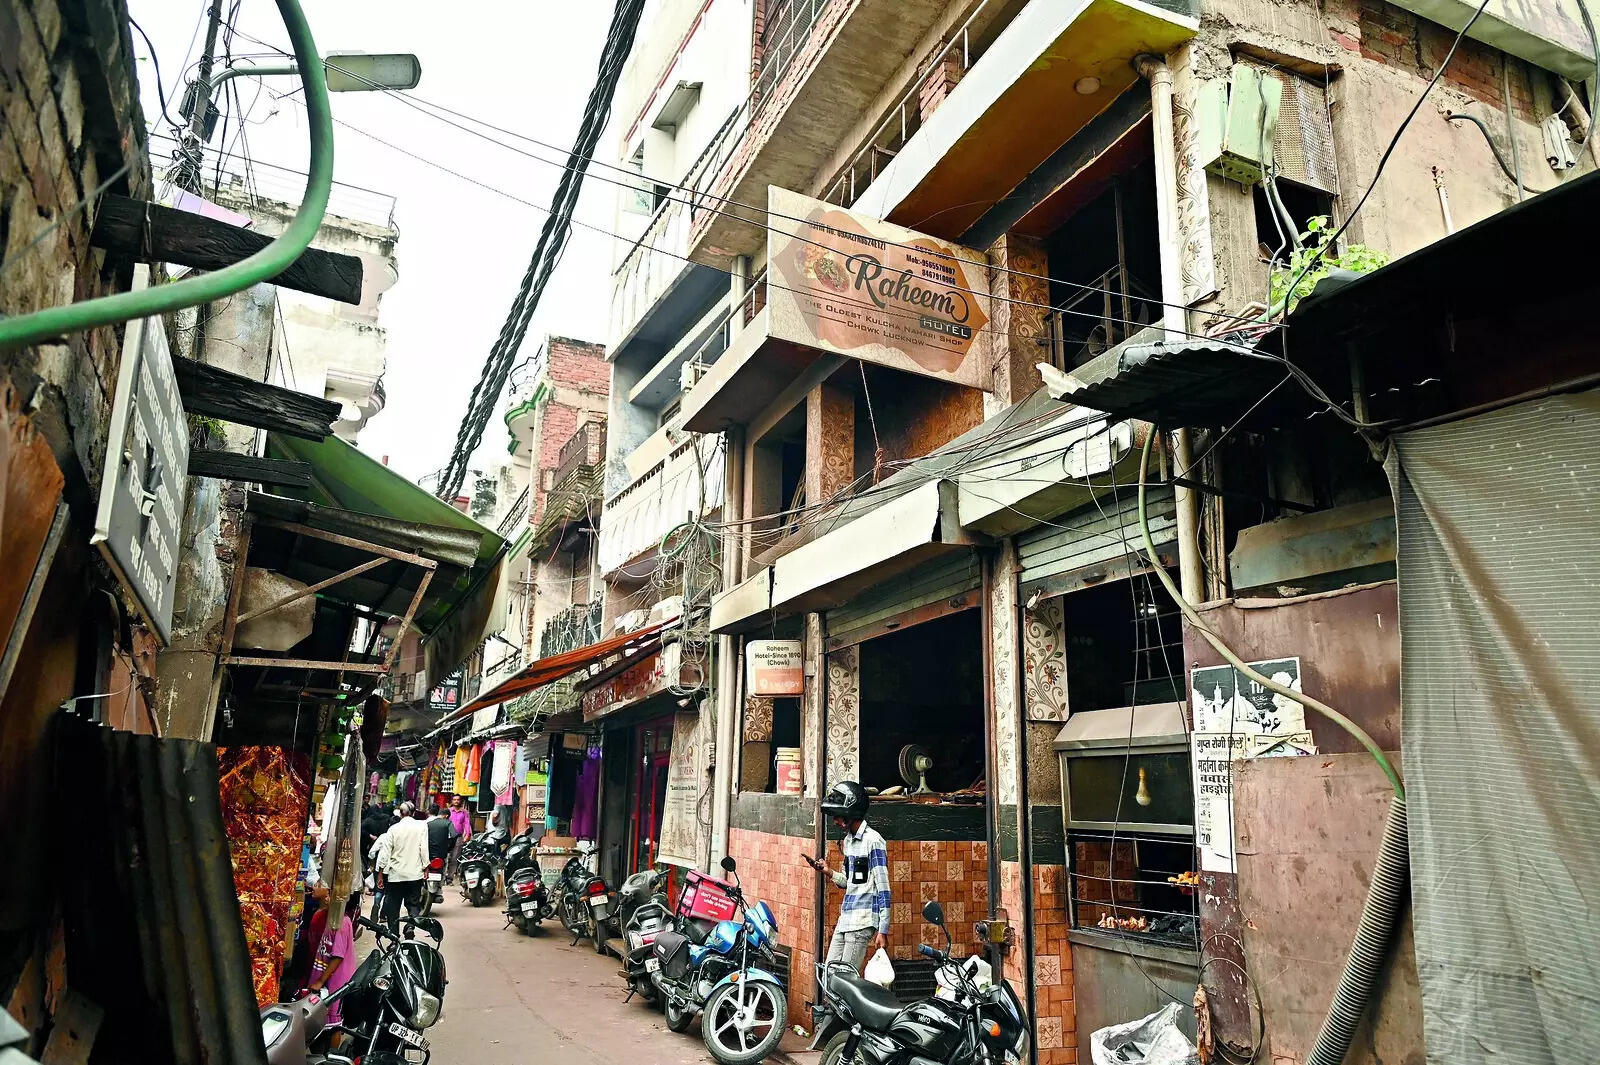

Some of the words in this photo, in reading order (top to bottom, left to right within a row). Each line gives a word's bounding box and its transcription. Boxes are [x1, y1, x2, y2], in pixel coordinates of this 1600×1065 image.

[846, 254, 969, 323] Raheem
[923, 317, 968, 338] HOTEL
[940, 335, 964, 346] SHOP
[1212, 736, 1226, 750] रोगी
